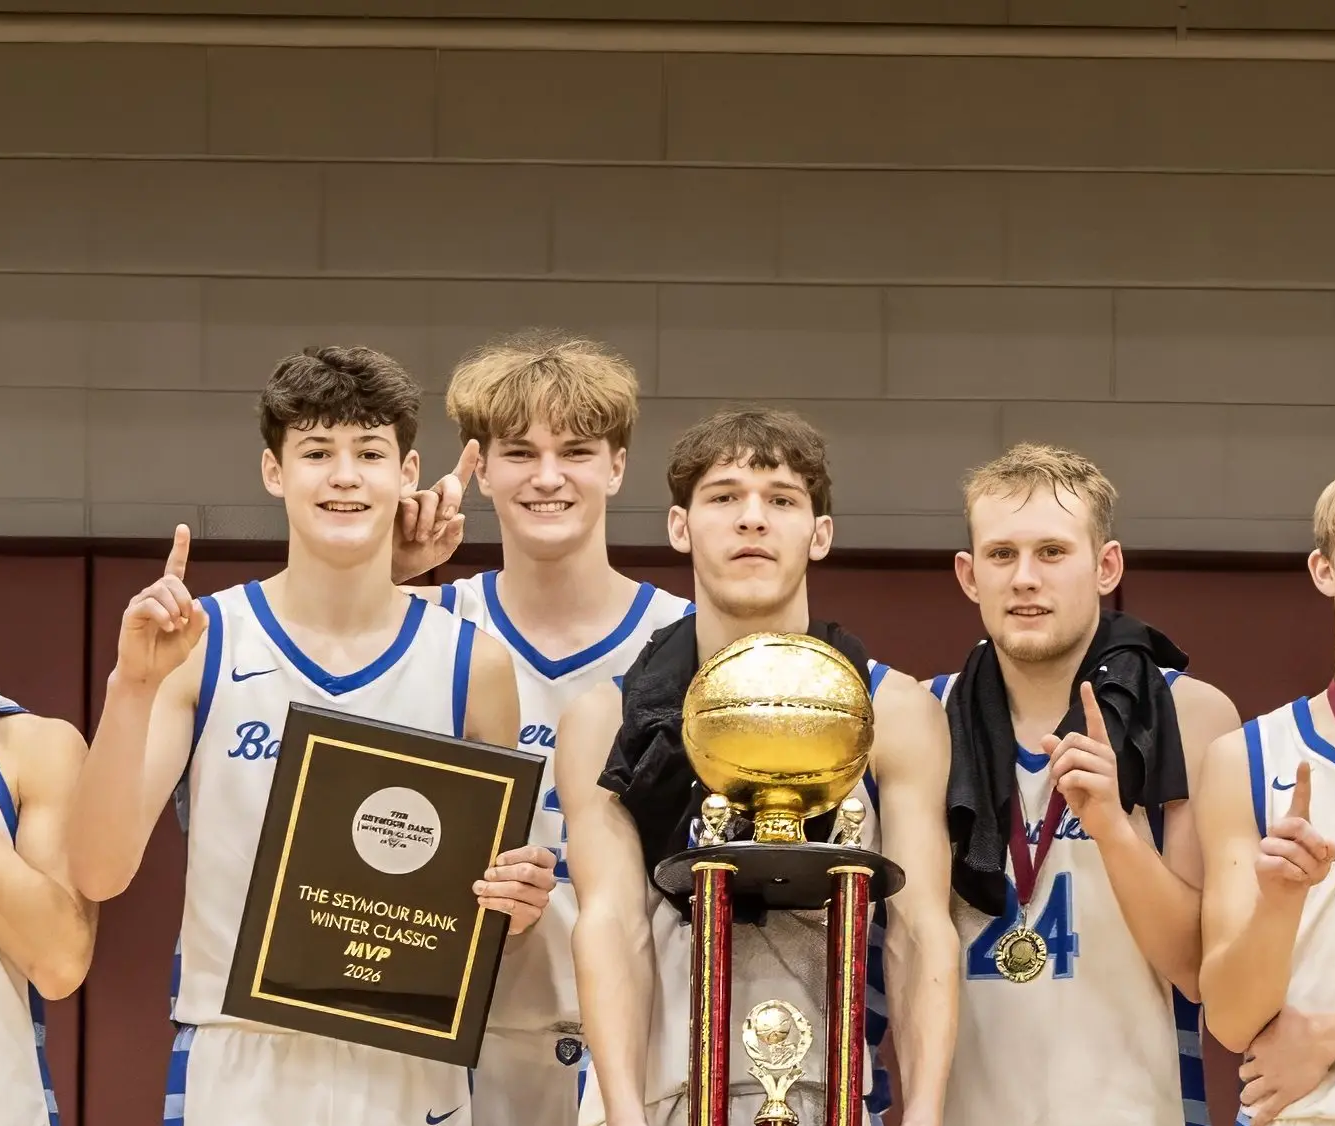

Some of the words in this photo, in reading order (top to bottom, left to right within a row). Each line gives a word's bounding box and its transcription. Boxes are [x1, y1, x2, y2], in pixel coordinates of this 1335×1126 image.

[298, 885, 330, 904] THE
[331, 893, 410, 922] SEYMOUR
[413, 909, 459, 932] BANK
[310, 909, 370, 936] WINTER
[373, 924, 439, 950] CLASSIC
[343, 940, 392, 962] MVP
[343, 963, 382, 983] 2026
